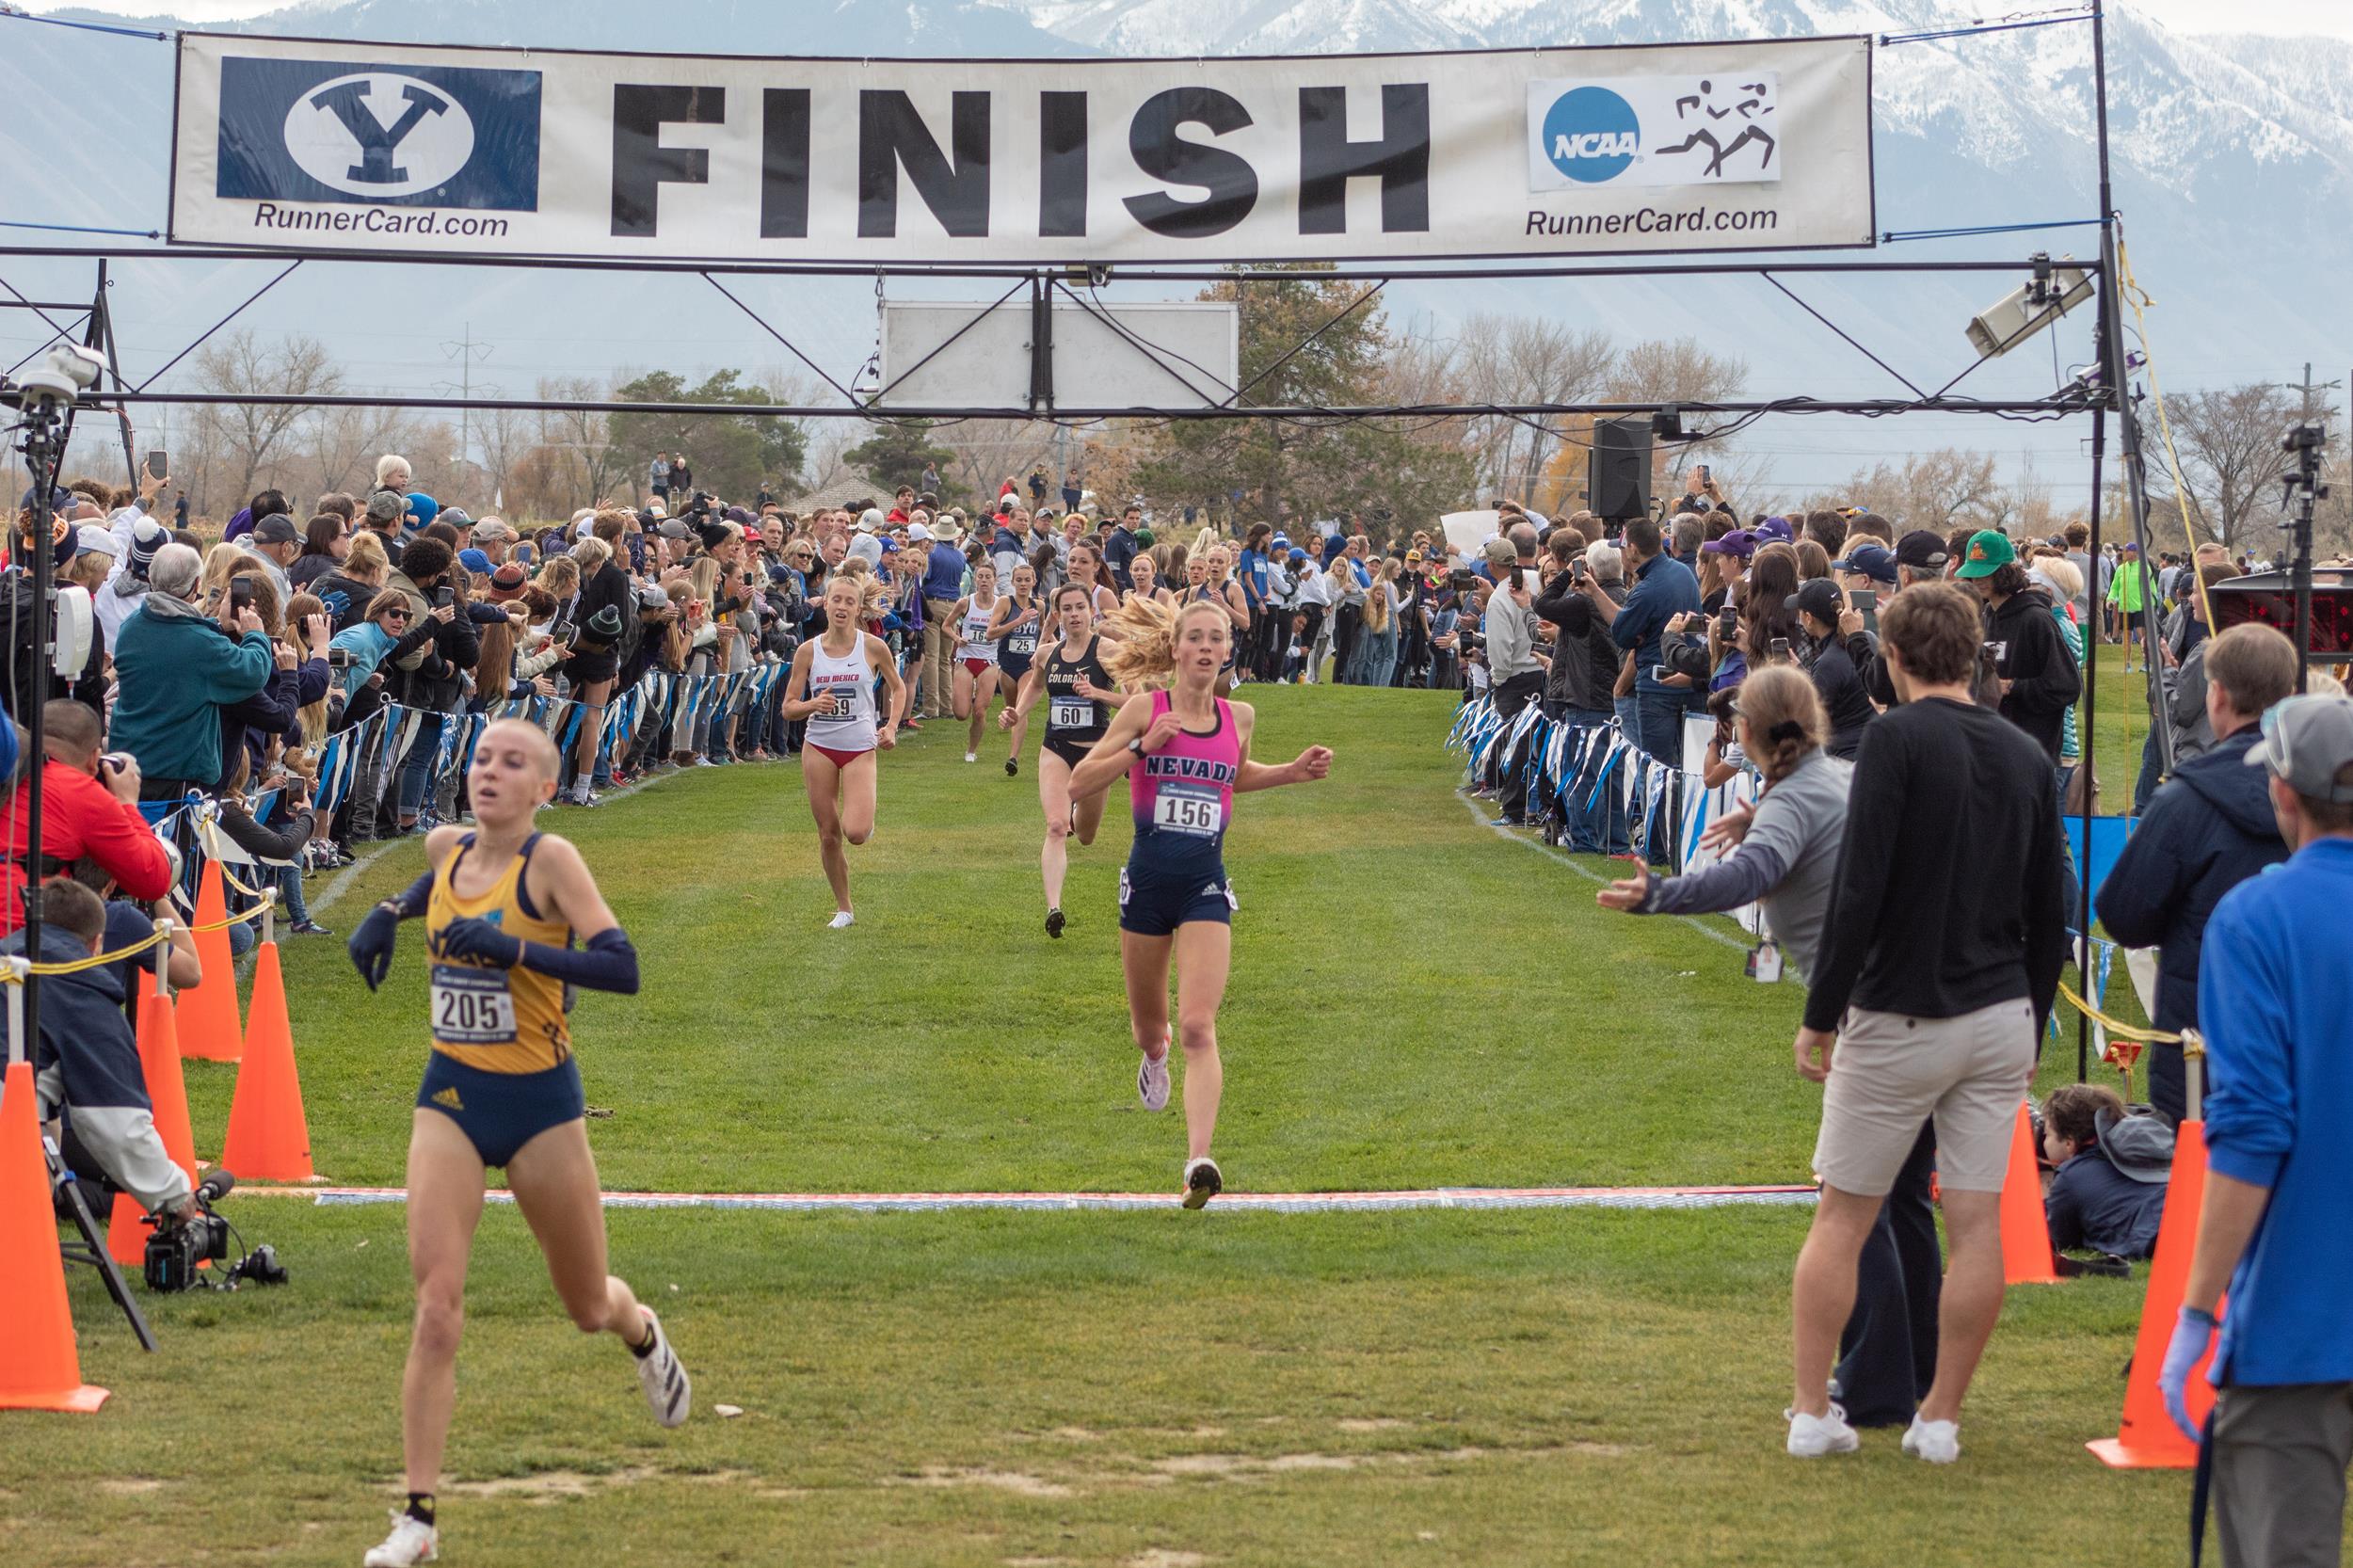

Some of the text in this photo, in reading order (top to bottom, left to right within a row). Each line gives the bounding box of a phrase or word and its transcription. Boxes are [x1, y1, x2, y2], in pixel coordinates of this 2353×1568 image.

[310, 81, 449, 184] Y
[1554, 132, 1636, 159] NCAA
[610, 83, 1430, 238] FINISH
[254, 202, 508, 236] RunnerCard.com
[1526, 206, 1777, 234] RunnerCard.com
[973, 632, 987, 641] 16
[1016, 640, 1030, 651] 25
[816, 674, 859, 684] NEW MEXICO
[1048, 673, 1090, 683] COLORAO
[1061, 708, 1080, 725] 60
[1144, 755, 1236, 786] NEVADA
[1165, 798, 1212, 827] 156
[440, 990, 500, 1030] 205
